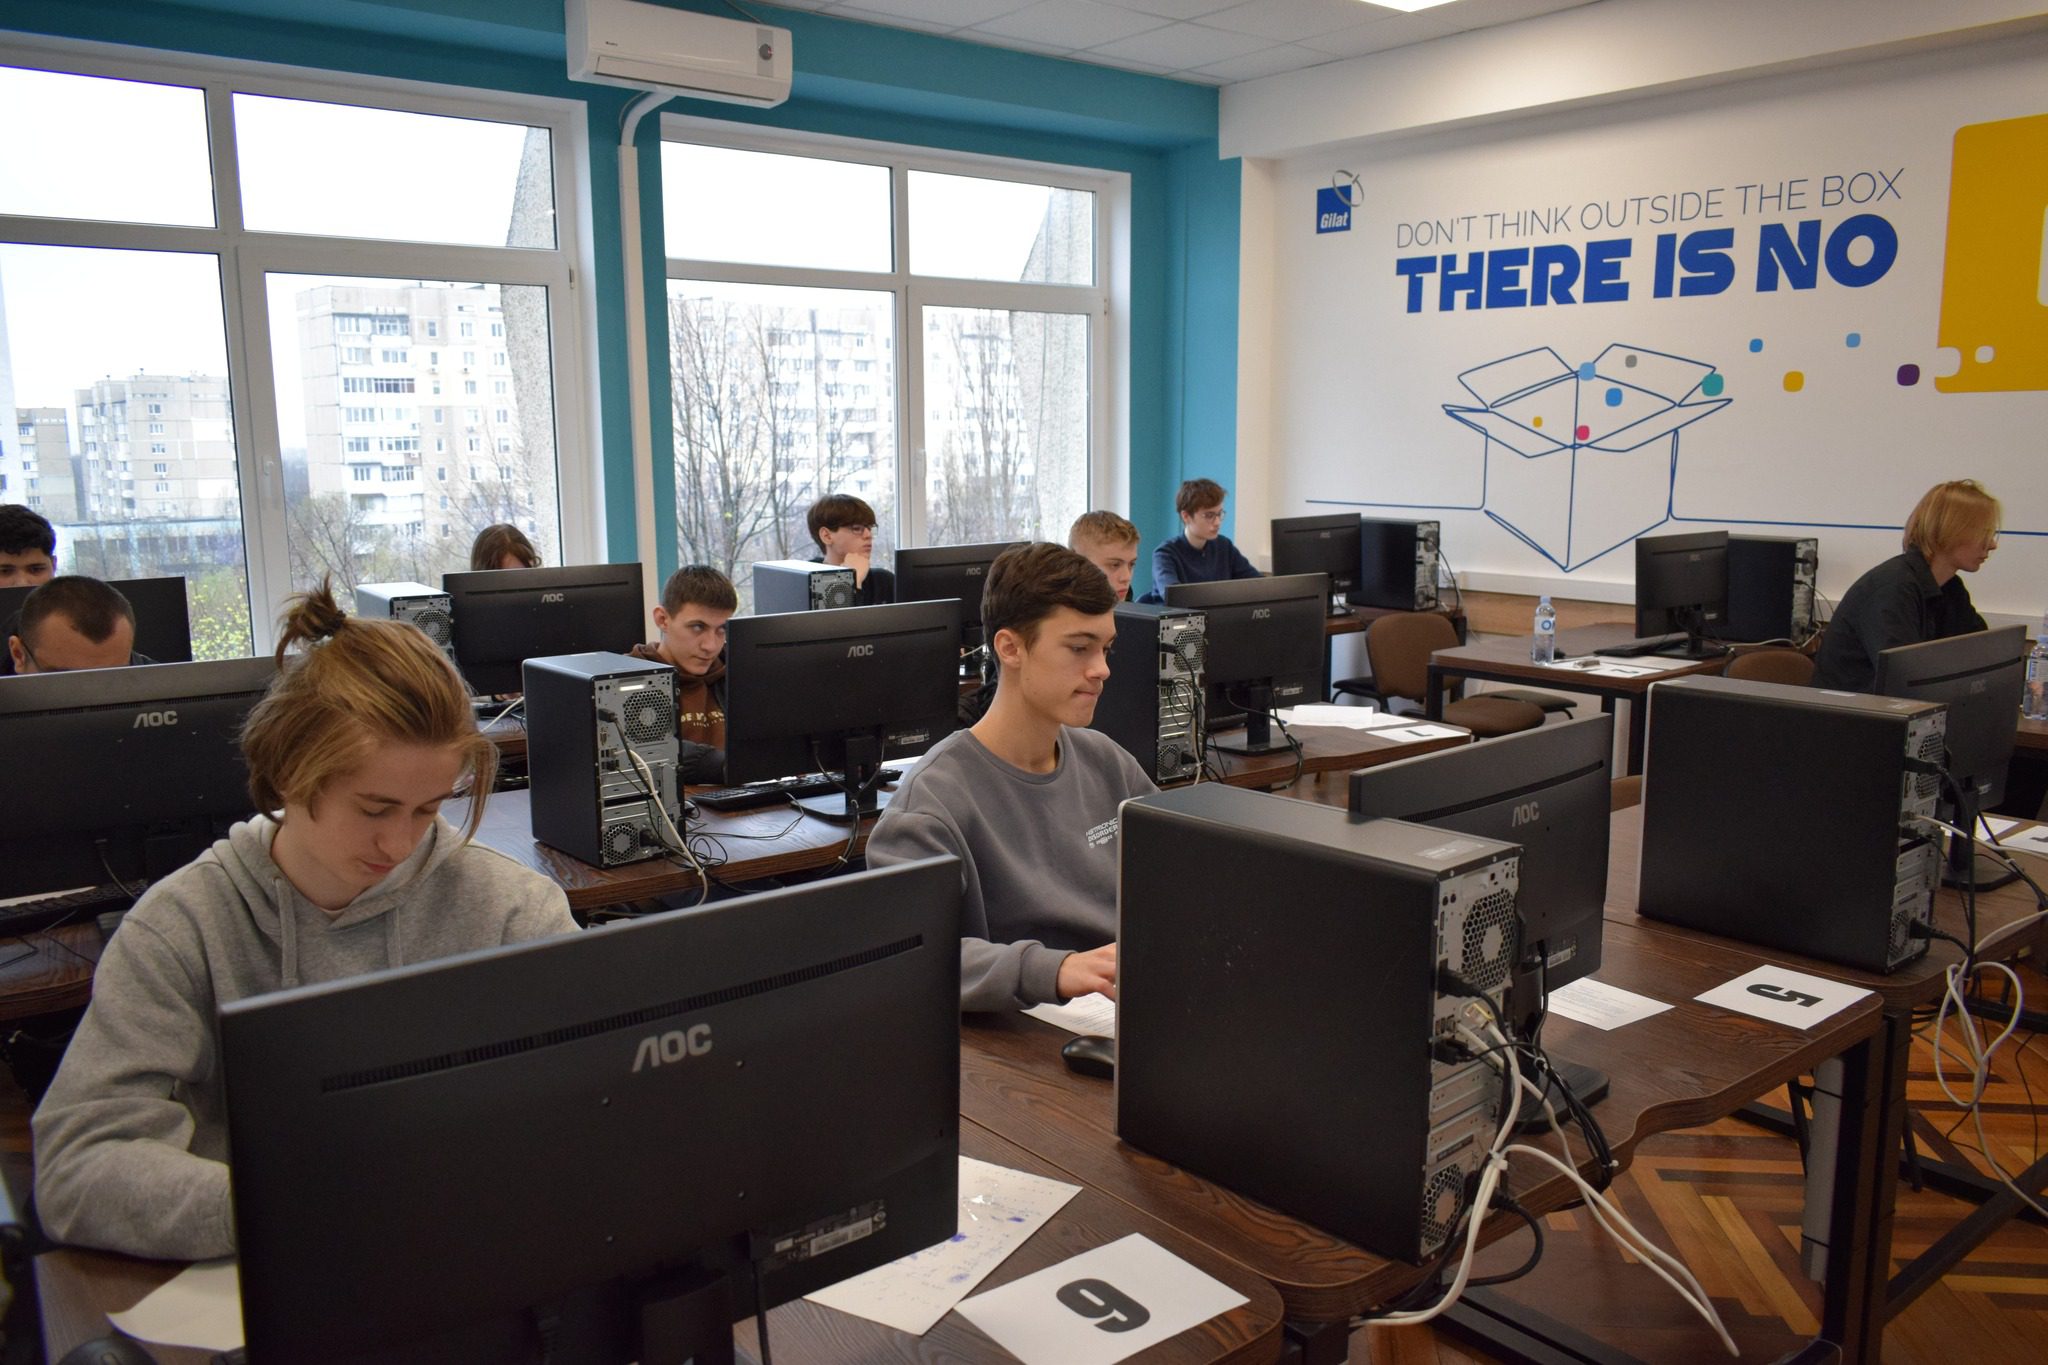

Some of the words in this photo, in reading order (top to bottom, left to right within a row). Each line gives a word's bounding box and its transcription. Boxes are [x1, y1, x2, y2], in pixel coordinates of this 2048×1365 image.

[1397, 215, 1477, 248] DON'T
[1483, 205, 1572, 240] THINK
[1580, 188, 1725, 231] OUTSIDE
[1735, 178, 1809, 215] THE
[1821, 167, 1905, 208] BOX
[1320, 211, 1348, 229] Gilat
[1395, 237, 1633, 314] THERE
[1653, 227, 1735, 299] IS
[1755, 213, 1899, 293] NO
[541, 593, 564, 603] AOC
[1251, 608, 1271, 620] AOC
[847, 644, 874, 658] AOC
[132, 710, 178, 729] AOC
[1511, 800, 1540, 827] AOC
[1745, 983, 1824, 1008] 5
[632, 1022, 713, 1073] AOC
